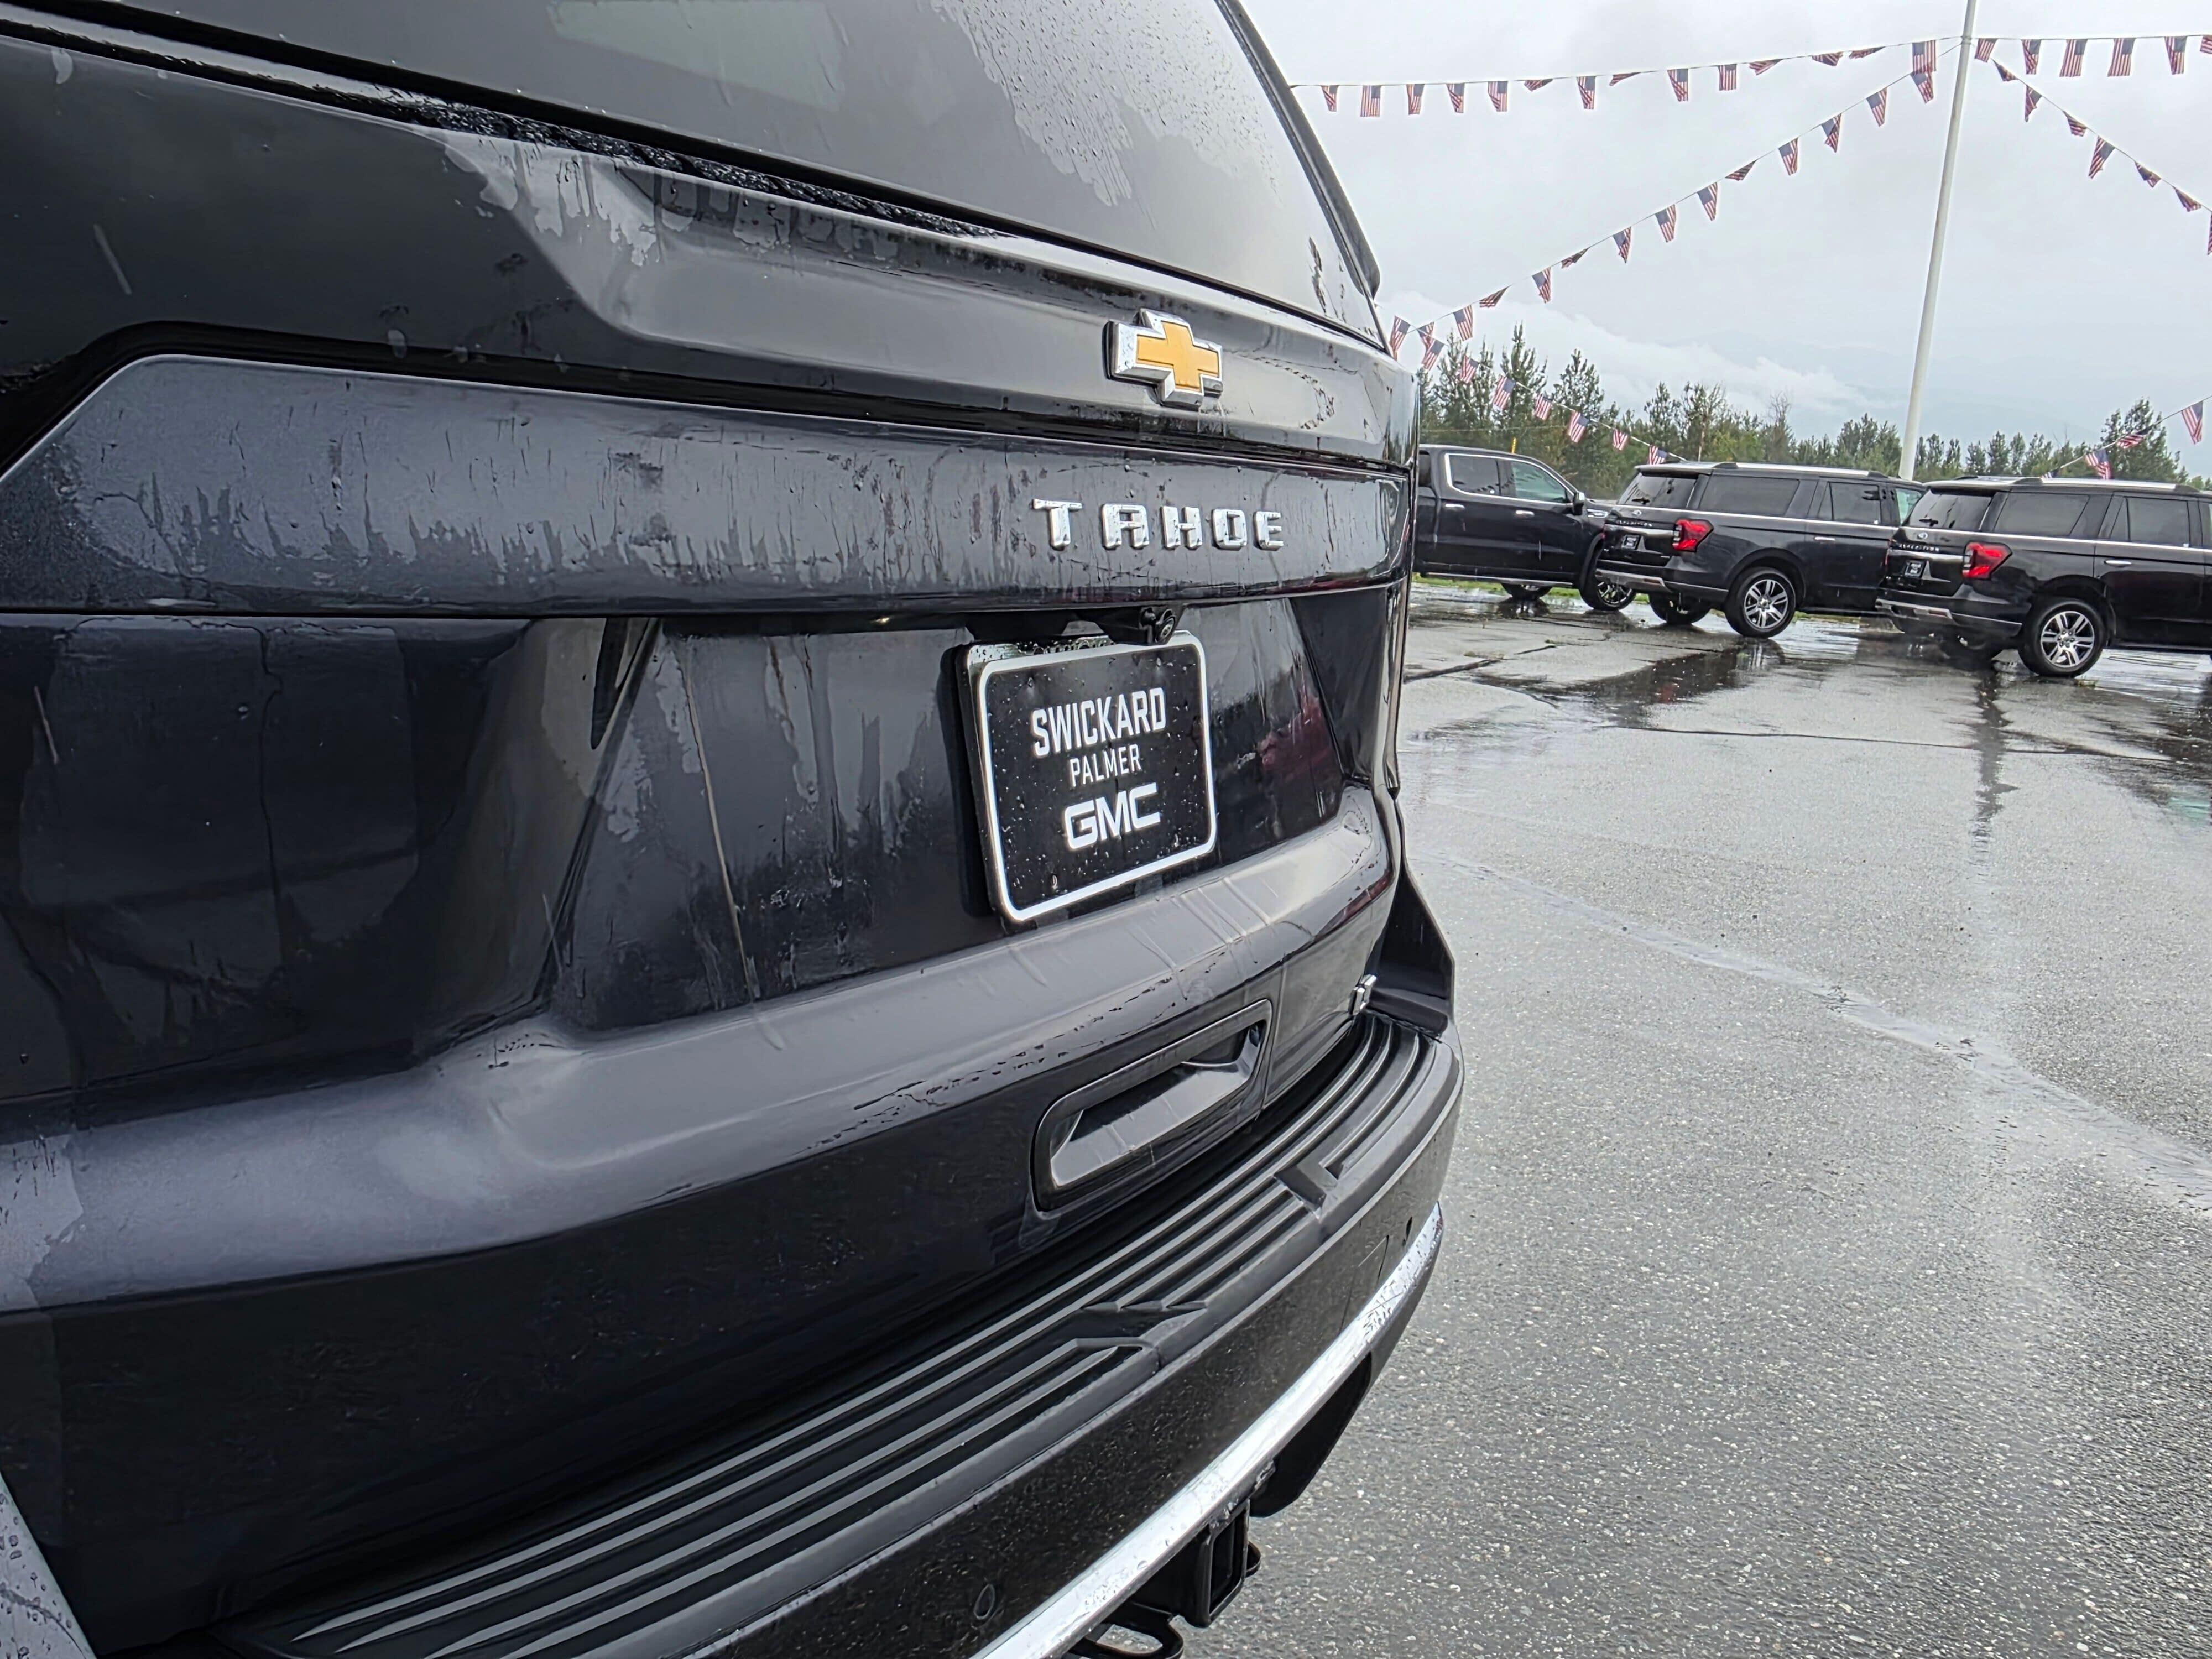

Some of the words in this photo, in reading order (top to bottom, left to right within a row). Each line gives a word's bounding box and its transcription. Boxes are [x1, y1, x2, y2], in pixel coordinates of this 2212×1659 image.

[1032, 499, 1284, 550] TAHOE
[1032, 687, 1166, 758] SWICKARD
[1070, 744, 1141, 787] PALMER
[1065, 782, 1161, 850] GMC
